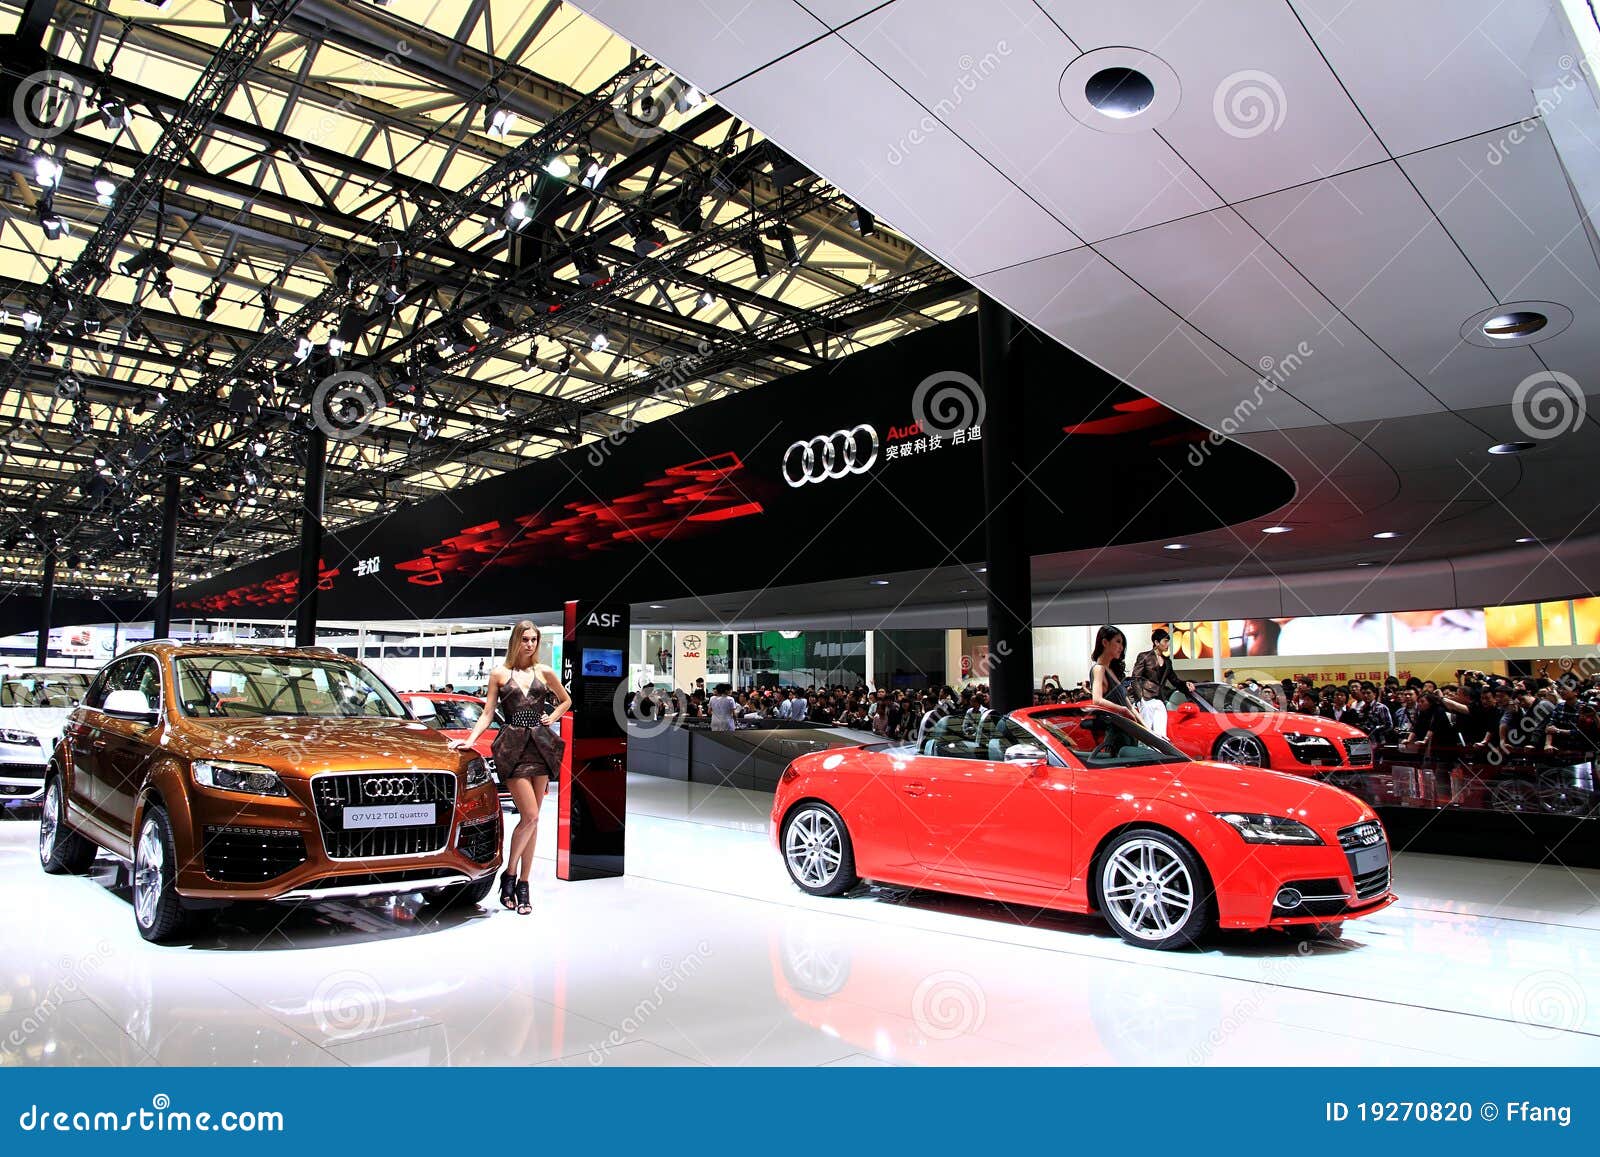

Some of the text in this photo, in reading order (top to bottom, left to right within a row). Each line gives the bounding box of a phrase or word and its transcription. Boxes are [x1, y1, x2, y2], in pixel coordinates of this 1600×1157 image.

[886, 418, 925, 441] Audi
[885, 424, 983, 461] 突破科技 启迪
[586, 612, 621, 628] ASF
[564, 658, 573, 694] ASF
[351, 811, 429, 822] Q7 V12 TDI quattro
